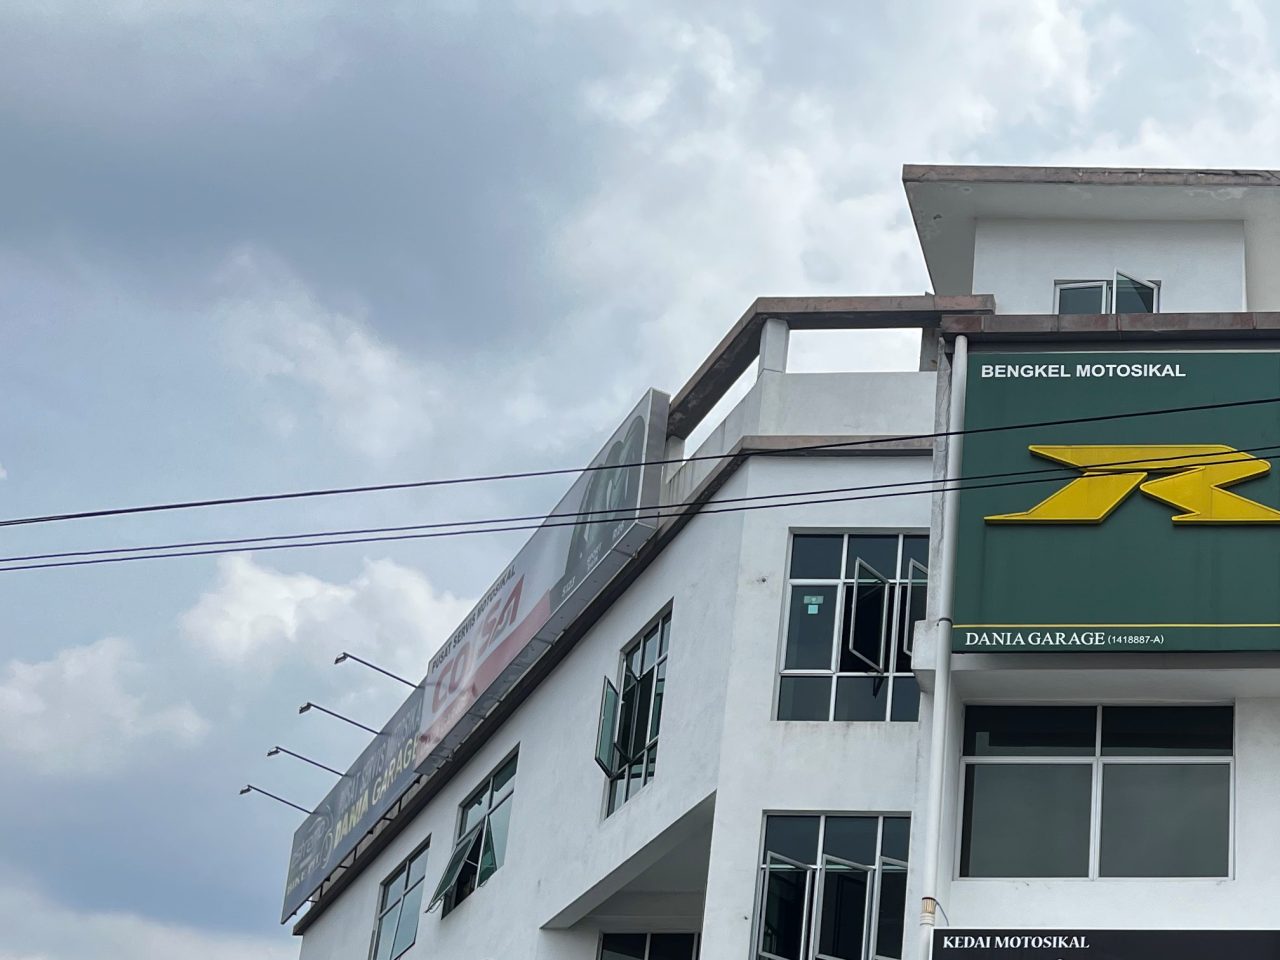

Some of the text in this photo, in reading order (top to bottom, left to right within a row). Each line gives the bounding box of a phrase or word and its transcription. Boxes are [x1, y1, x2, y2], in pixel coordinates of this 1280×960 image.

[981, 364, 1186, 378] BENGKEL MOTOSIKAL
[431, 574, 525, 715] COSA
[965, 632, 1164, 646] DANIA GARAGE (1418887-A)
[943, 936, 1090, 949] KEDAI MOTOSIKAL
